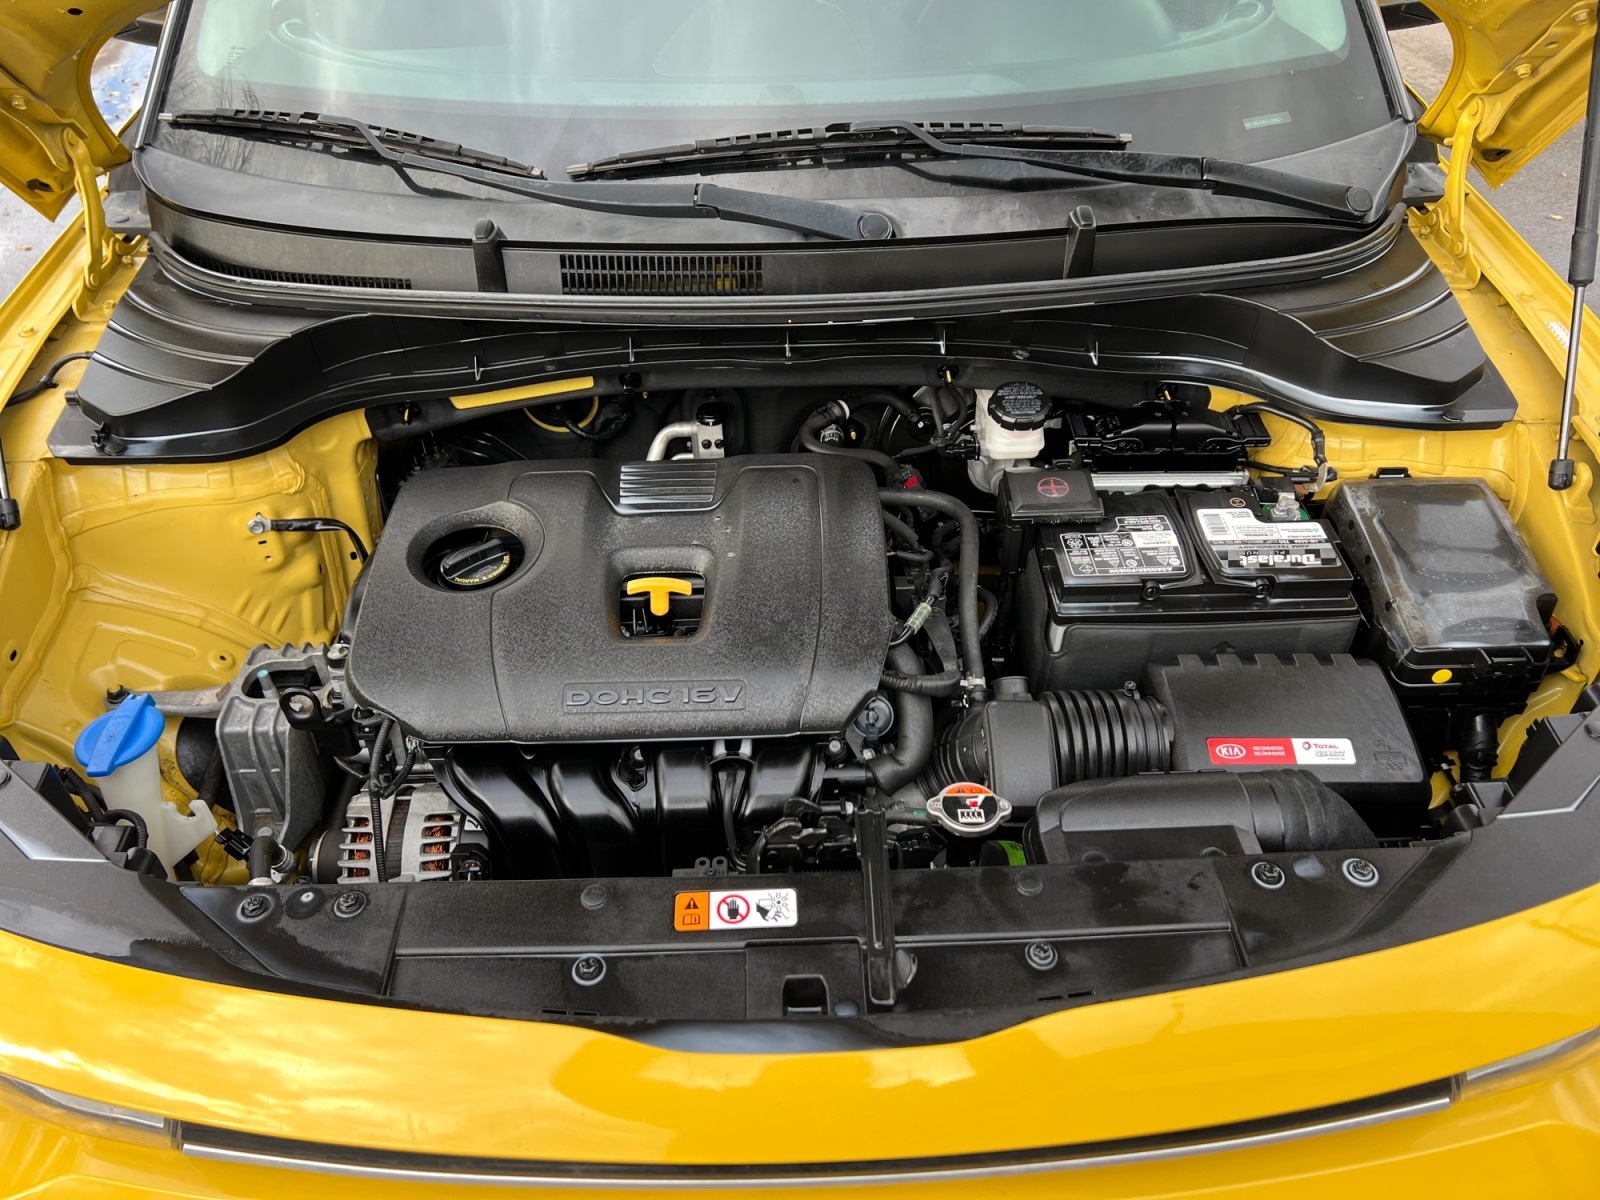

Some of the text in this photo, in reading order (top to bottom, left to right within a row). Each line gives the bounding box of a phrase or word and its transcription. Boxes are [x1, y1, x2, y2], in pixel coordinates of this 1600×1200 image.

[1239, 554, 1321, 566] Duralast
[565, 686, 743, 706] DOHC 16V
[1220, 746, 1243, 756] KIA
